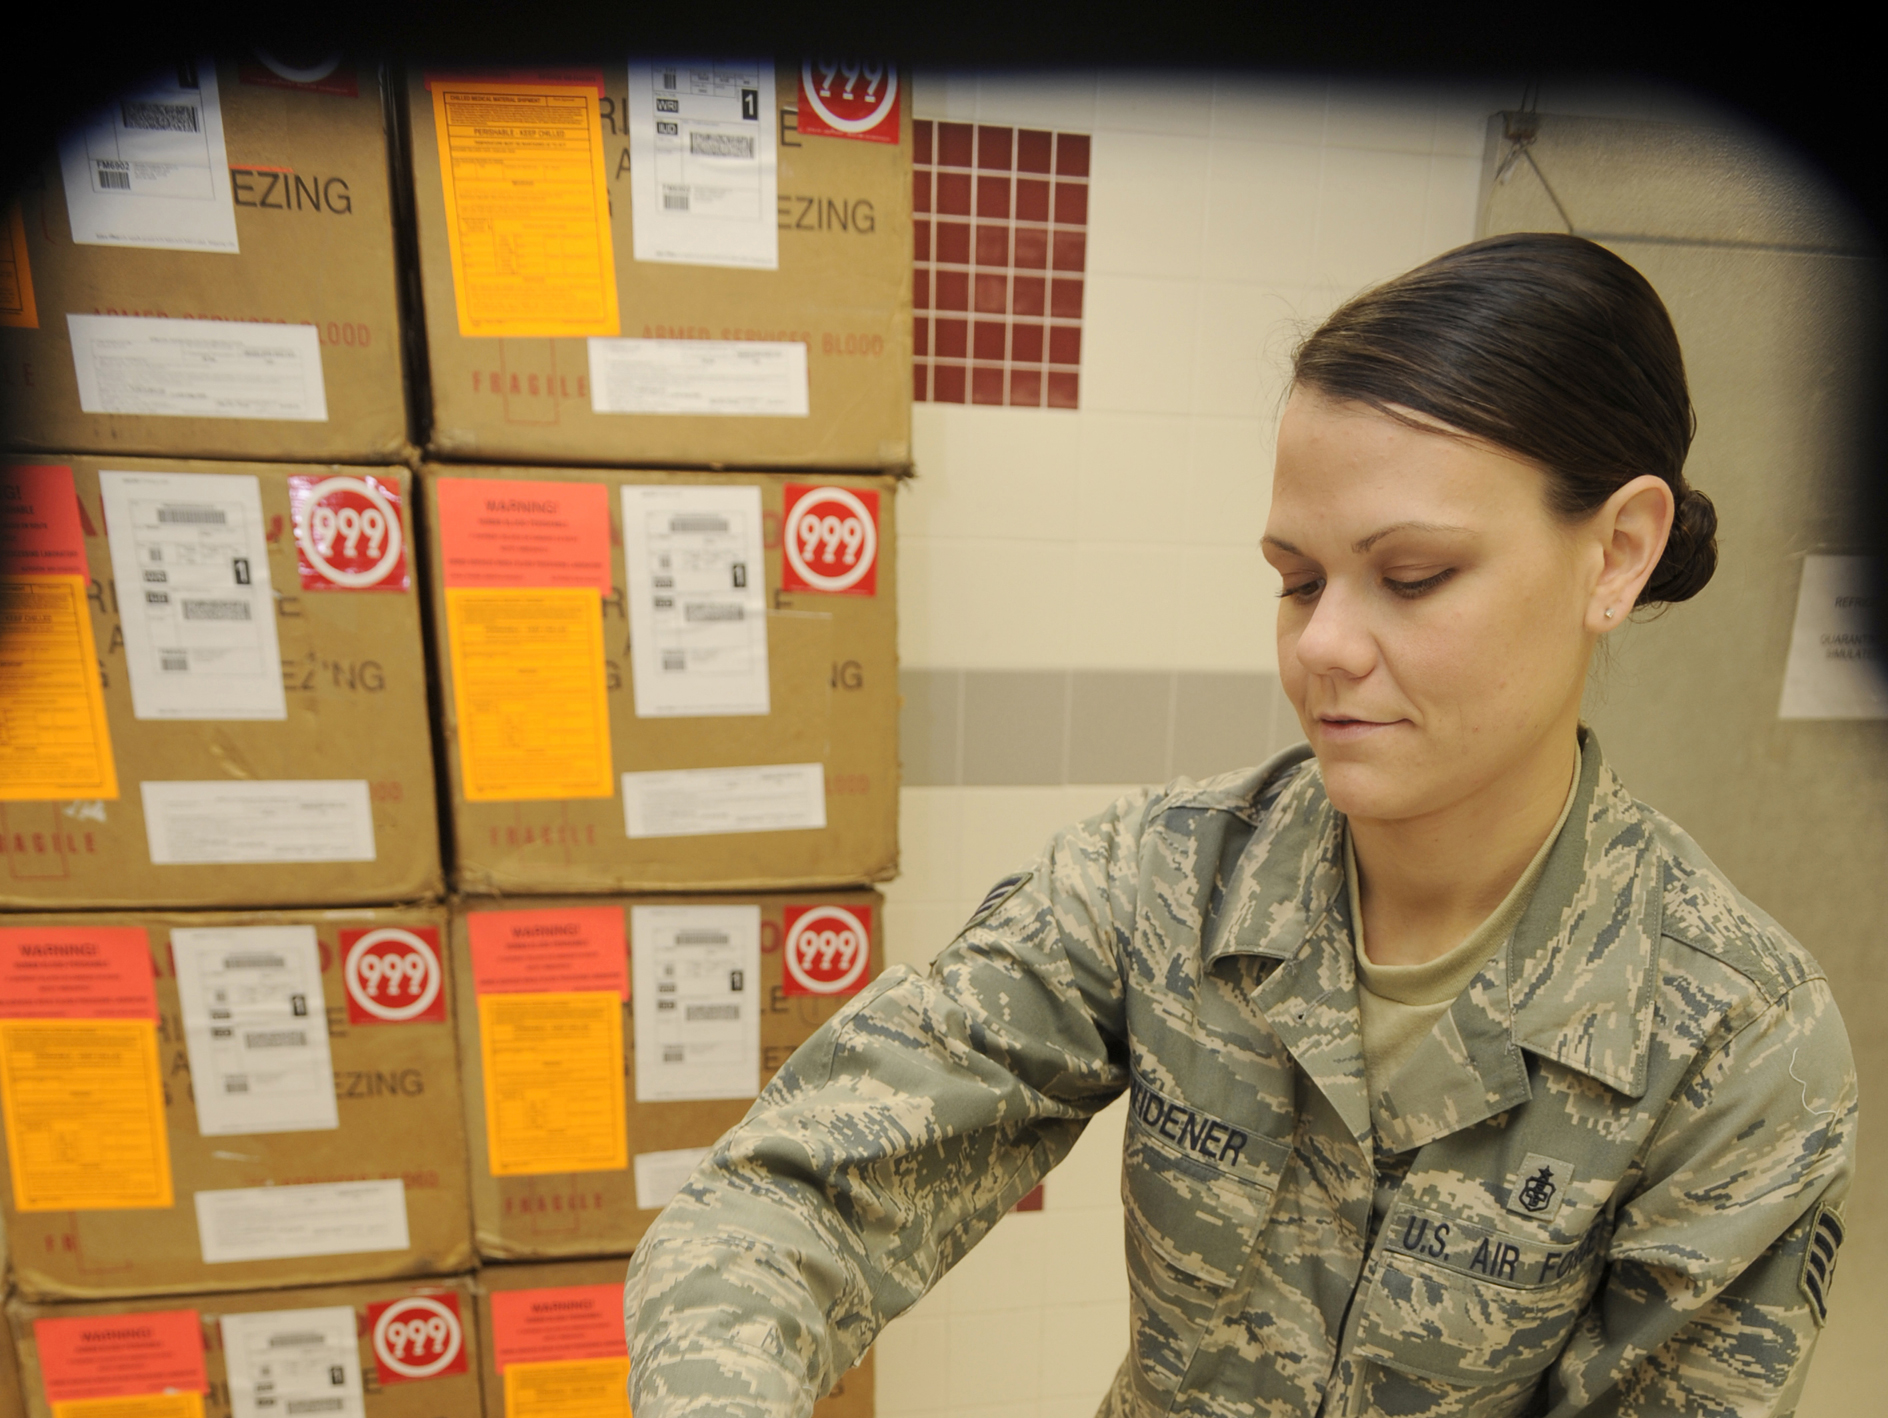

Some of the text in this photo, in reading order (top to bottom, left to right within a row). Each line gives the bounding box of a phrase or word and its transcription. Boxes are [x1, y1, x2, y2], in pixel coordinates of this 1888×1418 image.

[474, 128, 514, 137] PERISHABLE
[539, 130, 566, 138] CHILLED
[232, 168, 353, 215] EZING
[778, 195, 876, 234] EZING
[318, 320, 371, 348] LOOD
[822, 331, 884, 357] BLOOD
[472, 371, 588, 399] FRAGILE
[314, 507, 386, 558] 999
[800, 513, 863, 565] 999
[799, 928, 859, 971] 999
[358, 951, 428, 996] 999
[336, 1068, 425, 1098] EZING
[1403, 1215, 1450, 1262] U.S.
[1470, 1237, 1520, 1282] AIR
[386, 1316, 448, 1360] 999
